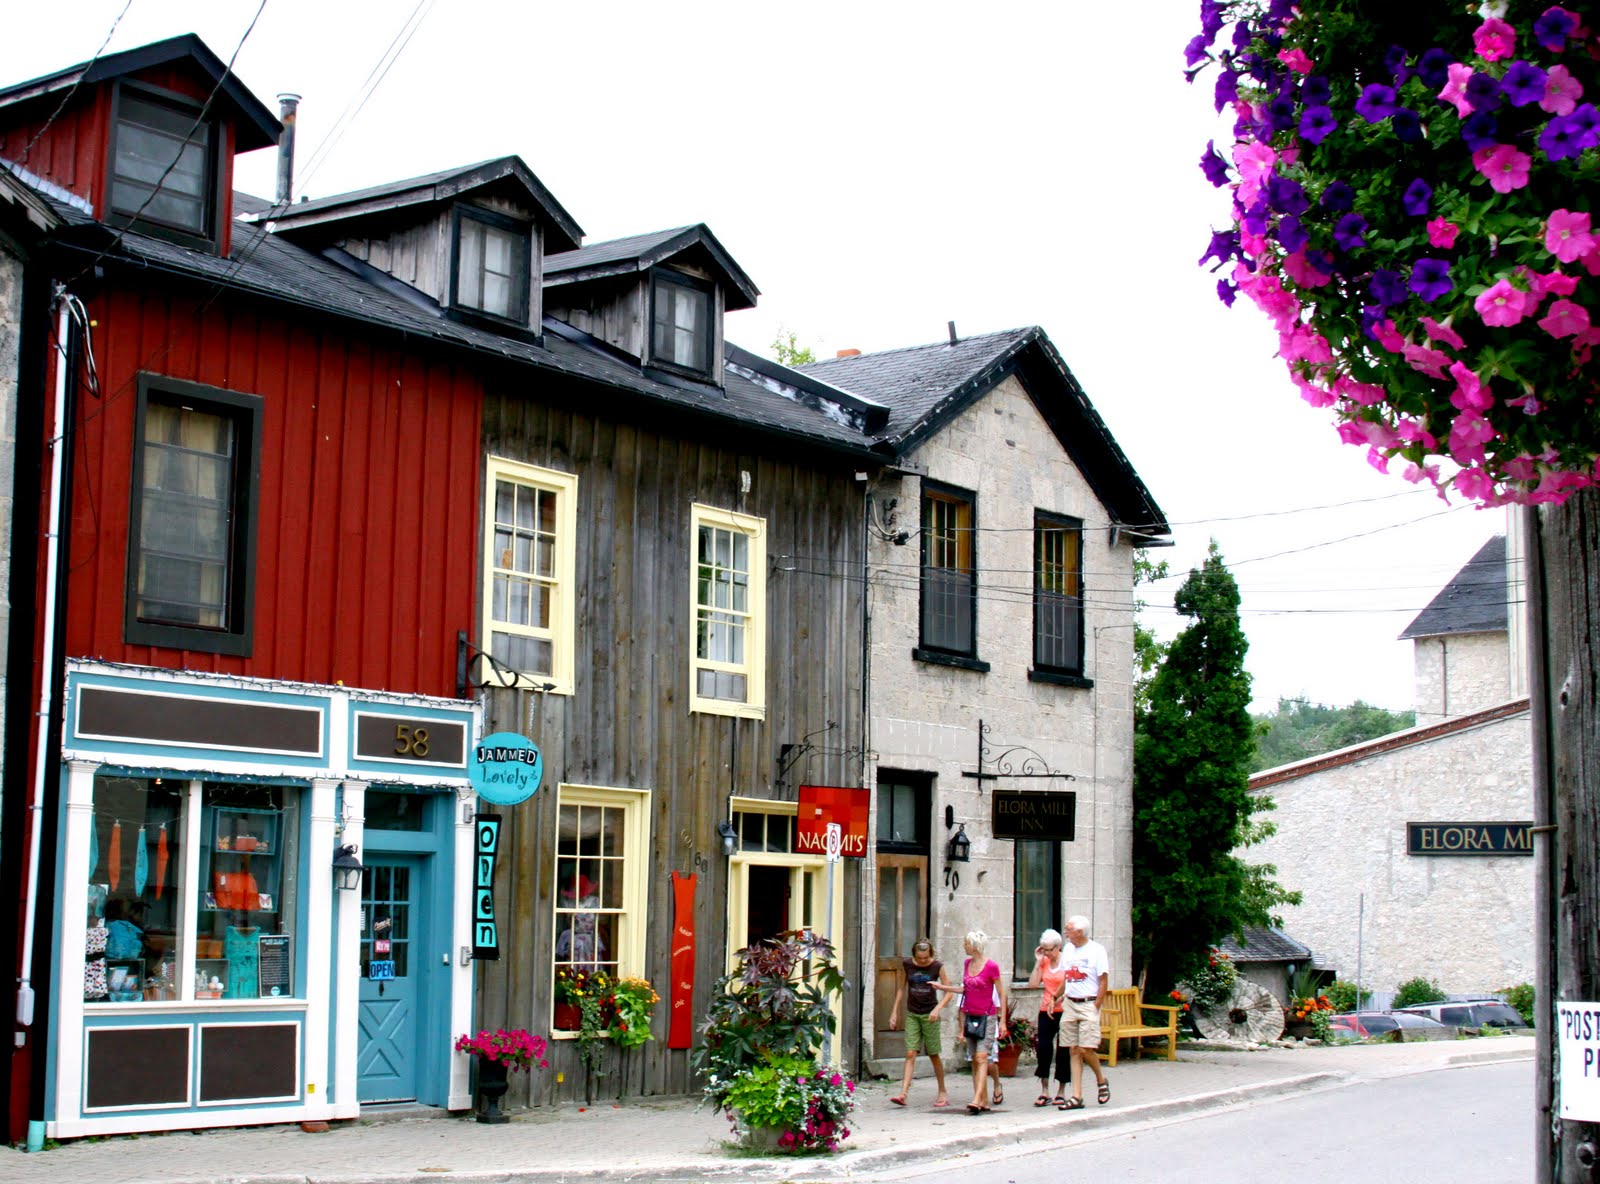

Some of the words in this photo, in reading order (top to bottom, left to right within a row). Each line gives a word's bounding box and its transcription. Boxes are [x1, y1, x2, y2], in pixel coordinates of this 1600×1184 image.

[395, 724, 429, 757] 58
[477, 746, 537, 764] JAMMED
[482, 764, 528, 790] Lovely
[999, 800, 1036, 815] ELORA
[1041, 801, 1069, 815] MILL
[1021, 817, 1044, 831] INN
[1421, 827, 1495, 849] ELORA
[695, 851, 708, 873] 60
[943, 866, 959, 891] 70
[370, 963, 394, 977] OPEN
[1584, 1048, 1600, 1078] P
